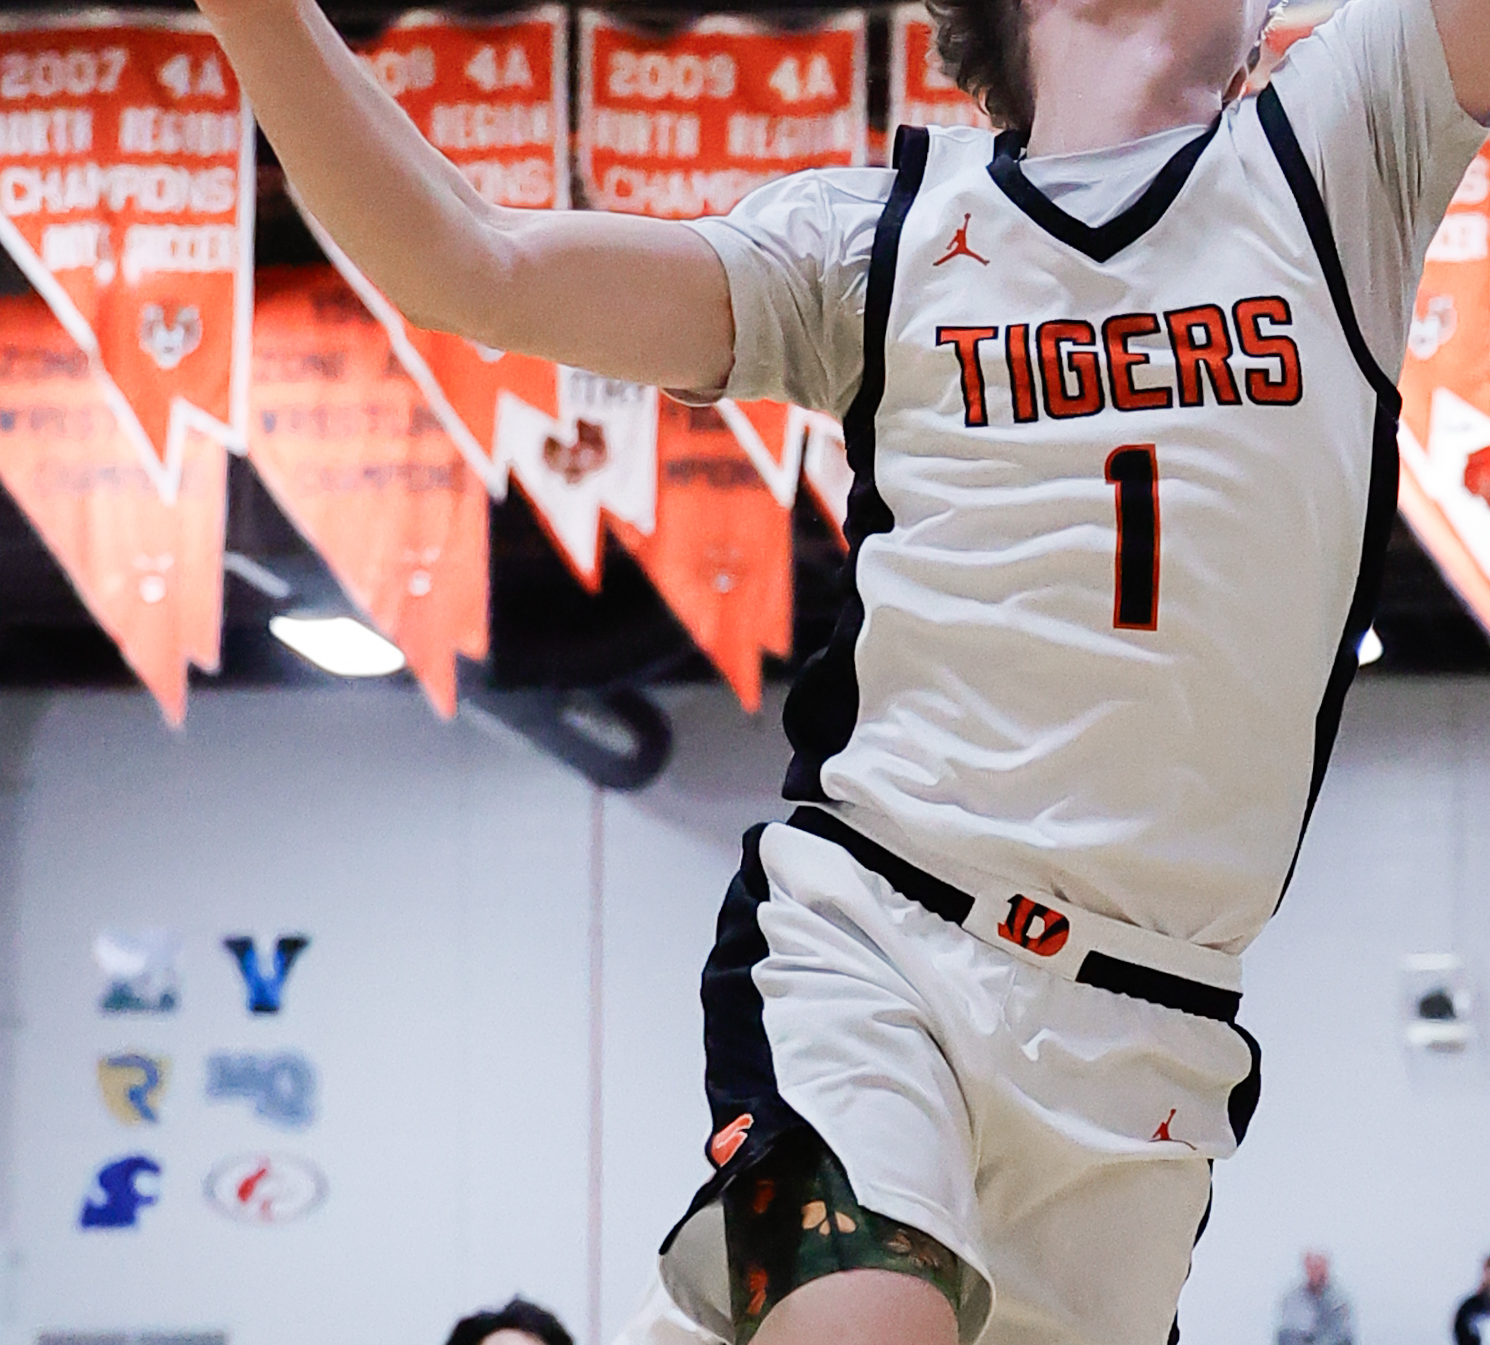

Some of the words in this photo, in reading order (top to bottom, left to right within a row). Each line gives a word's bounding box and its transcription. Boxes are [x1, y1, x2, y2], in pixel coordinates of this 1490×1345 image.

[0, 48, 129, 99] 2007
[157, 52, 227, 99] 4A
[463, 42, 534, 93] 4A
[767, 56, 838, 105] 4A
[935, 294, 1304, 428] TIGERS
[1104, 443, 1161, 632] 1
[222, 931, 313, 1016] V
